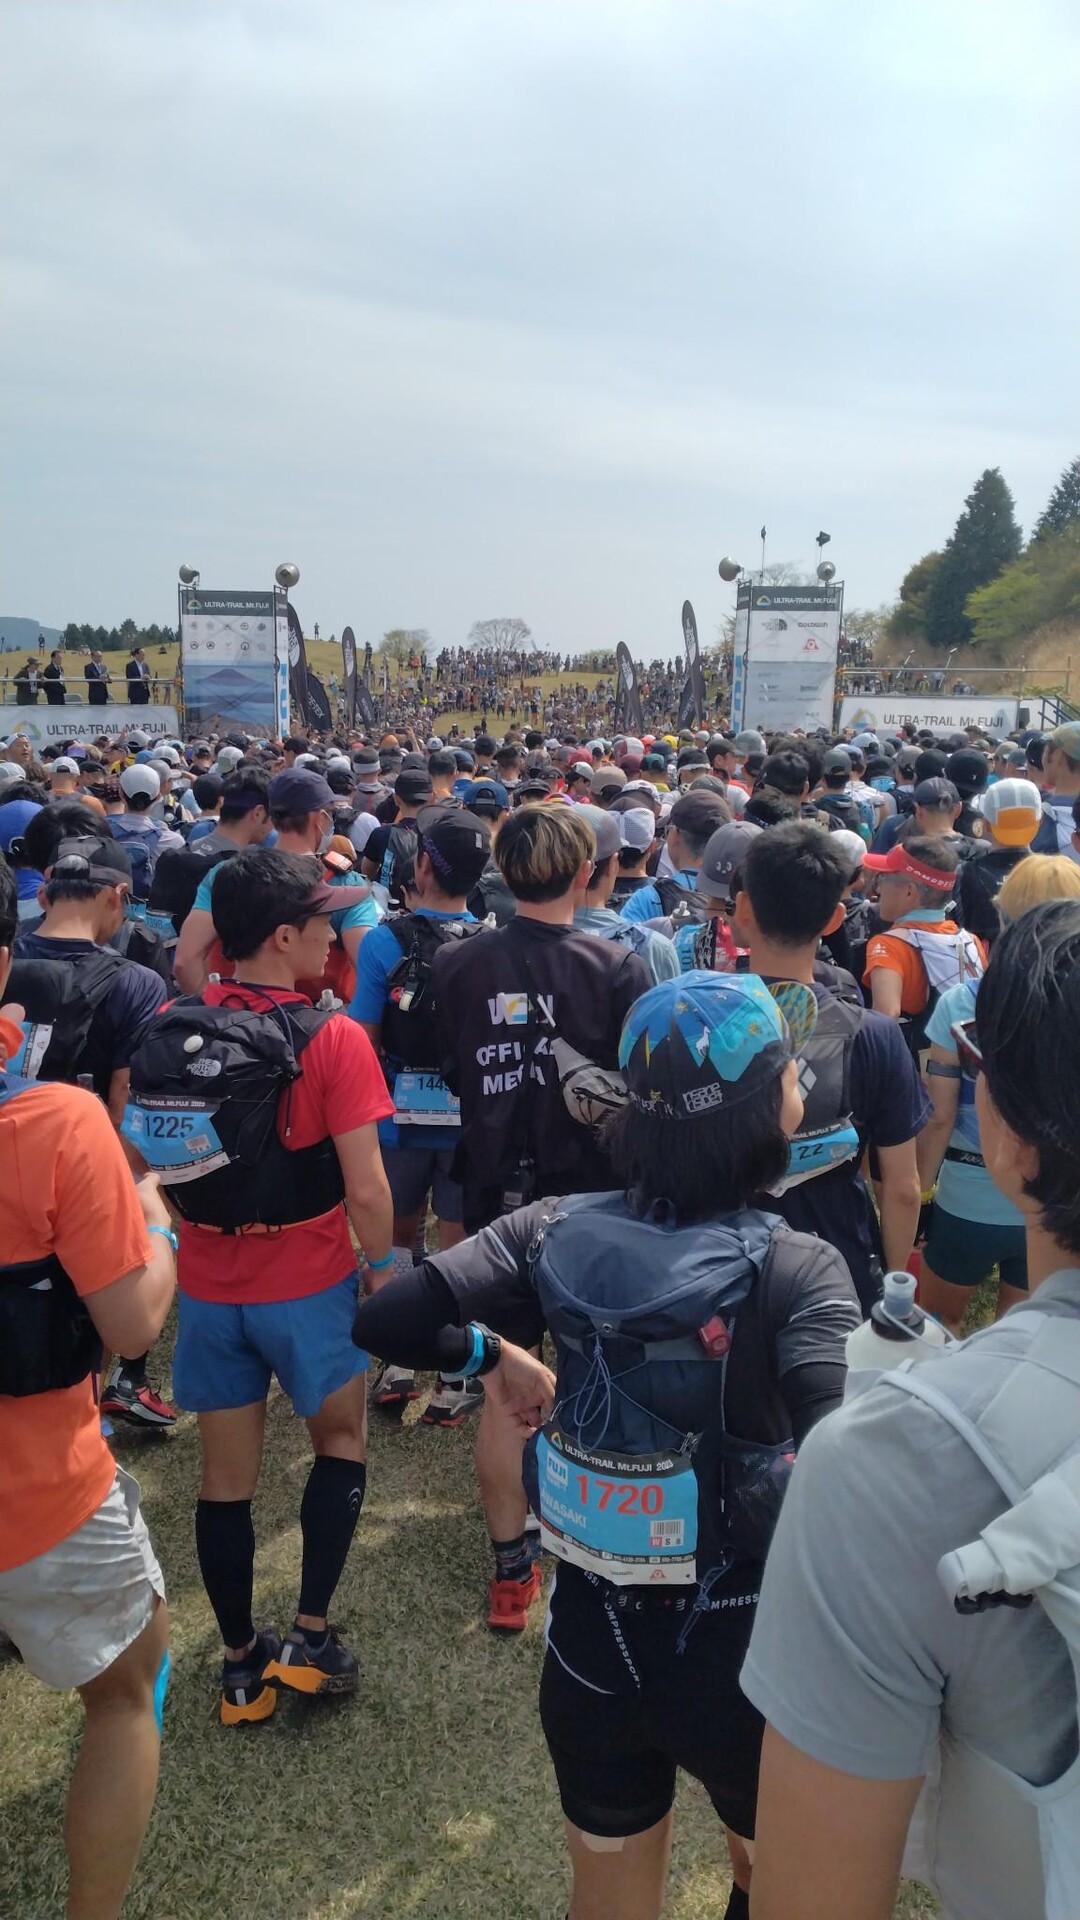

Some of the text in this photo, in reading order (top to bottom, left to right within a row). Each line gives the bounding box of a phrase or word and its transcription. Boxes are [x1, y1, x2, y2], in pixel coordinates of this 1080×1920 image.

[47, 724, 120, 736] ULTRA-TRAIL
[884, 714, 956, 727] ULTRA-TRAIL
[145, 1115, 194, 1139] 1225
[564, 1443, 616, 1470] ULTRA-TRAIL
[617, 1461, 653, 1472] Mt.FUJI
[549, 1460, 567, 1478] FUJI
[576, 1475, 664, 1515] 1720
